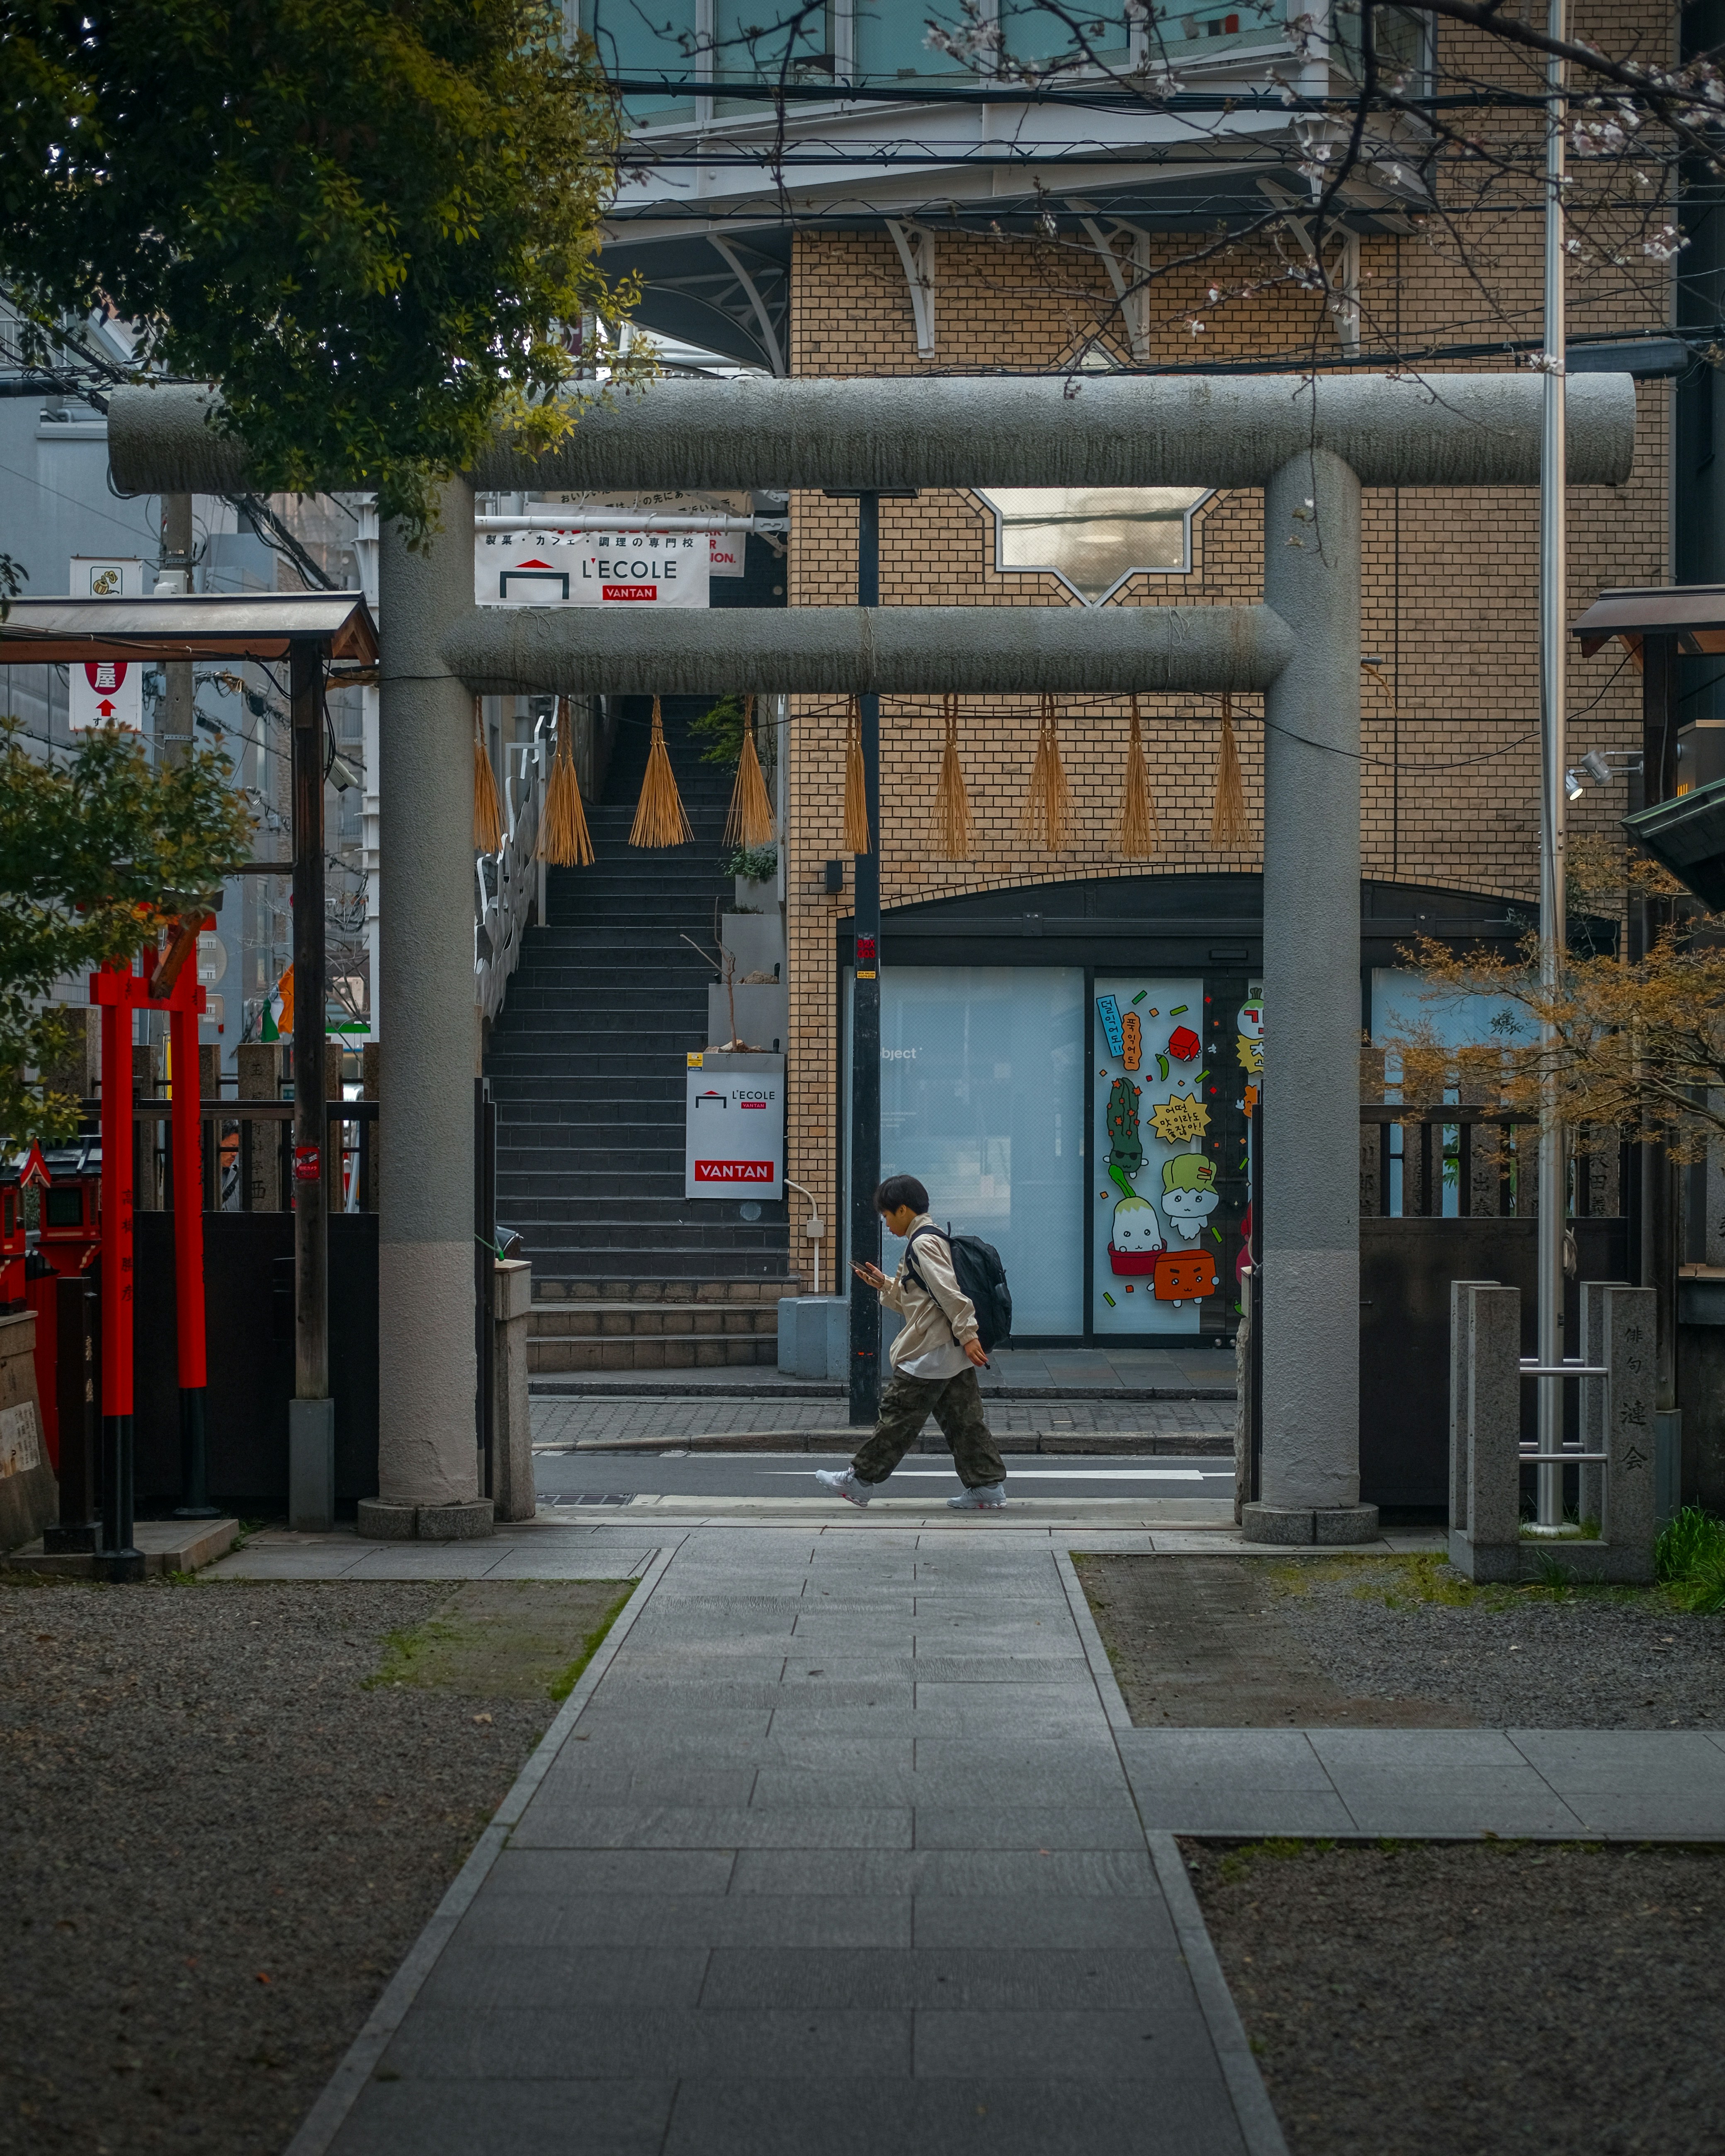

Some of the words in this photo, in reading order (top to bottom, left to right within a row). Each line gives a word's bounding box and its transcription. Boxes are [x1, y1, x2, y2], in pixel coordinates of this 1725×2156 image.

[486, 535, 694, 548] 製菓・カフェ・調理の専門校
[709, 553, 736, 563] ION.
[583, 558, 677, 579] L'ECOLE
[606, 588, 653, 597] VANTAN
[95, 663, 116, 688] 屋
[880, 1047, 916, 1061] bject
[732, 1090, 775, 1100] L'ECOLE
[1166, 1103, 1188, 1114] 어떤
[700, 1165, 768, 1178] VANTAN
